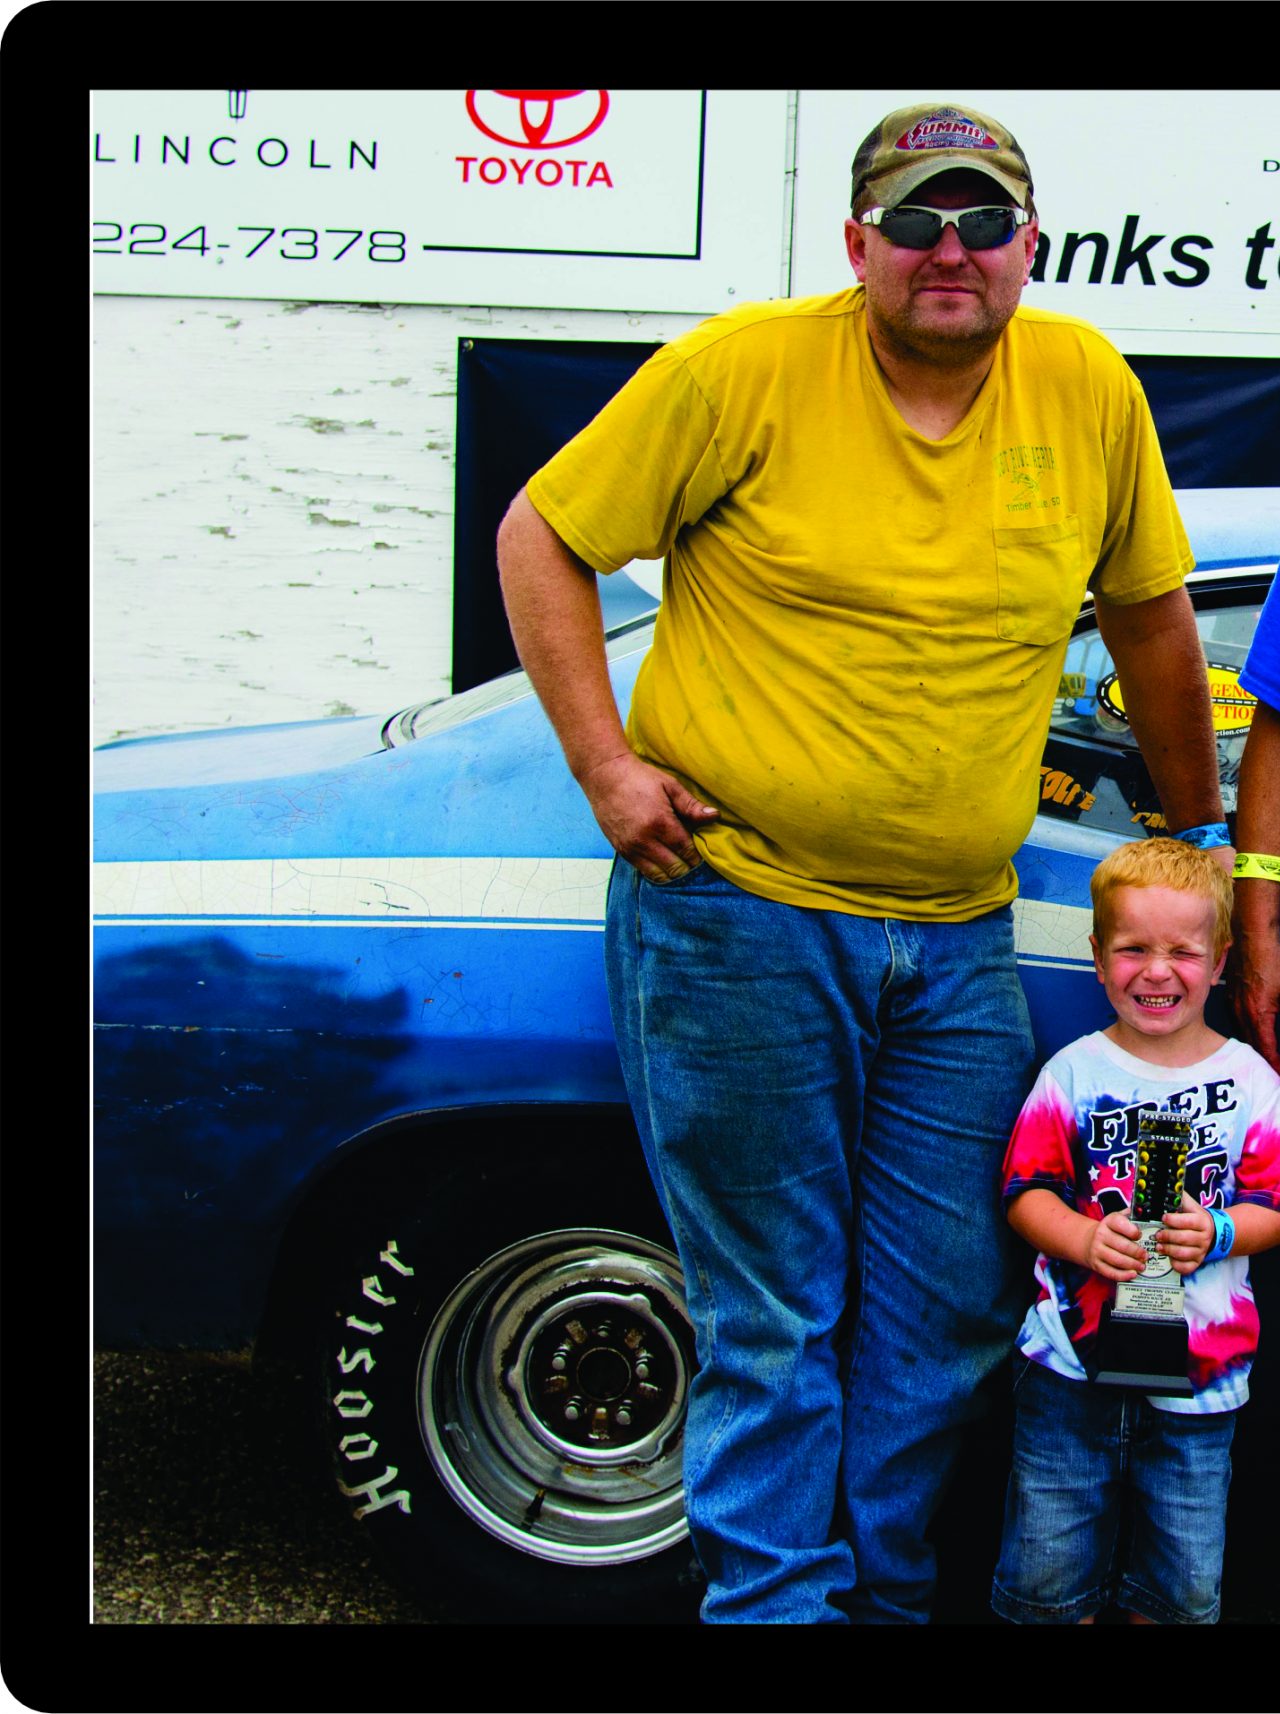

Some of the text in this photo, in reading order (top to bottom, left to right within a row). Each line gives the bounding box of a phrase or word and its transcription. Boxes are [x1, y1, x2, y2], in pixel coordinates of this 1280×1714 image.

[94, 133, 378, 171] LINCOLN
[456, 156, 614, 188] TOYOTA
[92, 222, 407, 263] 224-7378
[1144, 1113, 1192, 1123] PRE-STAGED
[1150, 1134, 1180, 1142] STAGED
[333, 1240, 415, 1521] Hoosier
